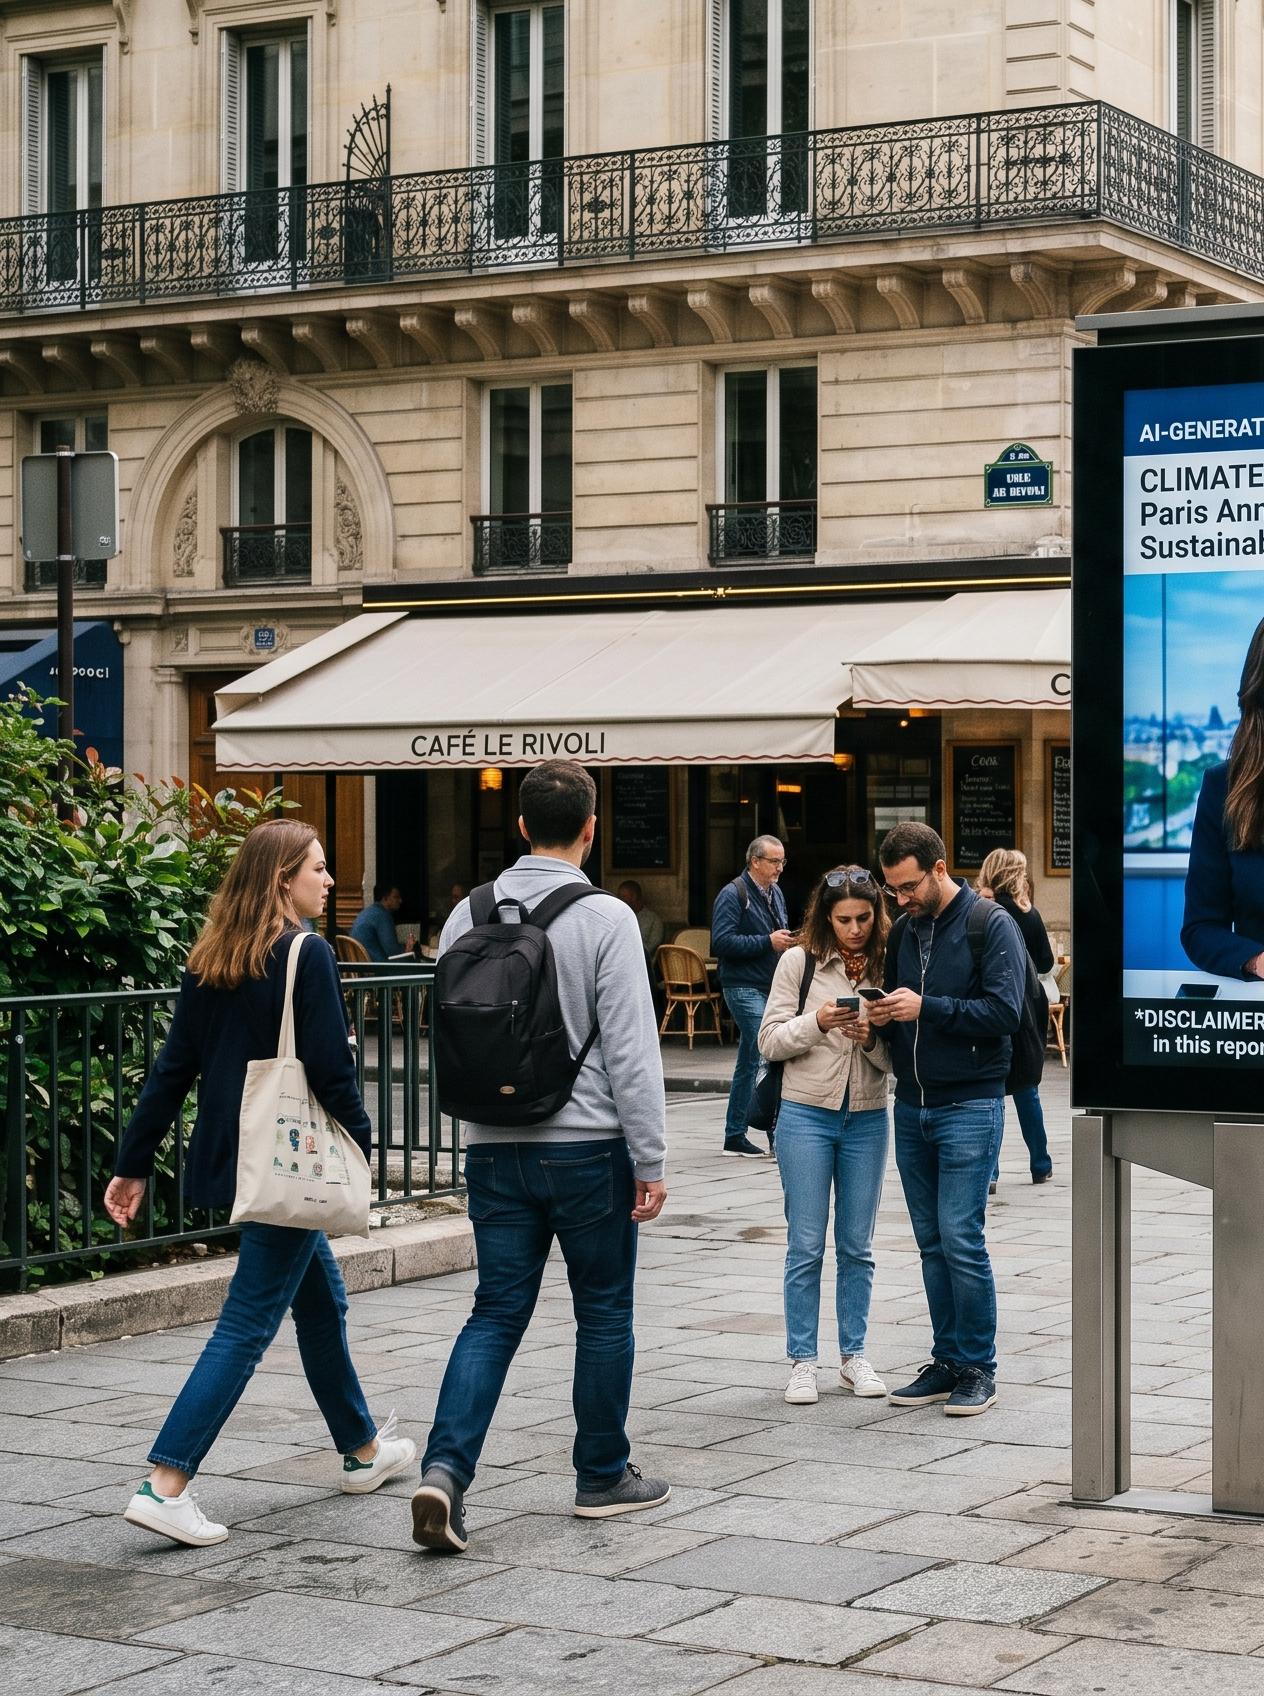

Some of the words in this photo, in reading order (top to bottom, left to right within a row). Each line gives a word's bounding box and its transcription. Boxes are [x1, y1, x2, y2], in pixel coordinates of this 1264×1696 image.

[1140, 463, 1264, 493] CLIMATE
[1140, 500, 1208, 526] Paris
[410, 729, 477, 758] CAFÉ
[484, 733, 513, 756] LE
[522, 731, 606, 756] RIVOLI
[1153, 1034, 1170, 1053] in
[1175, 1035, 1211, 1054] this
